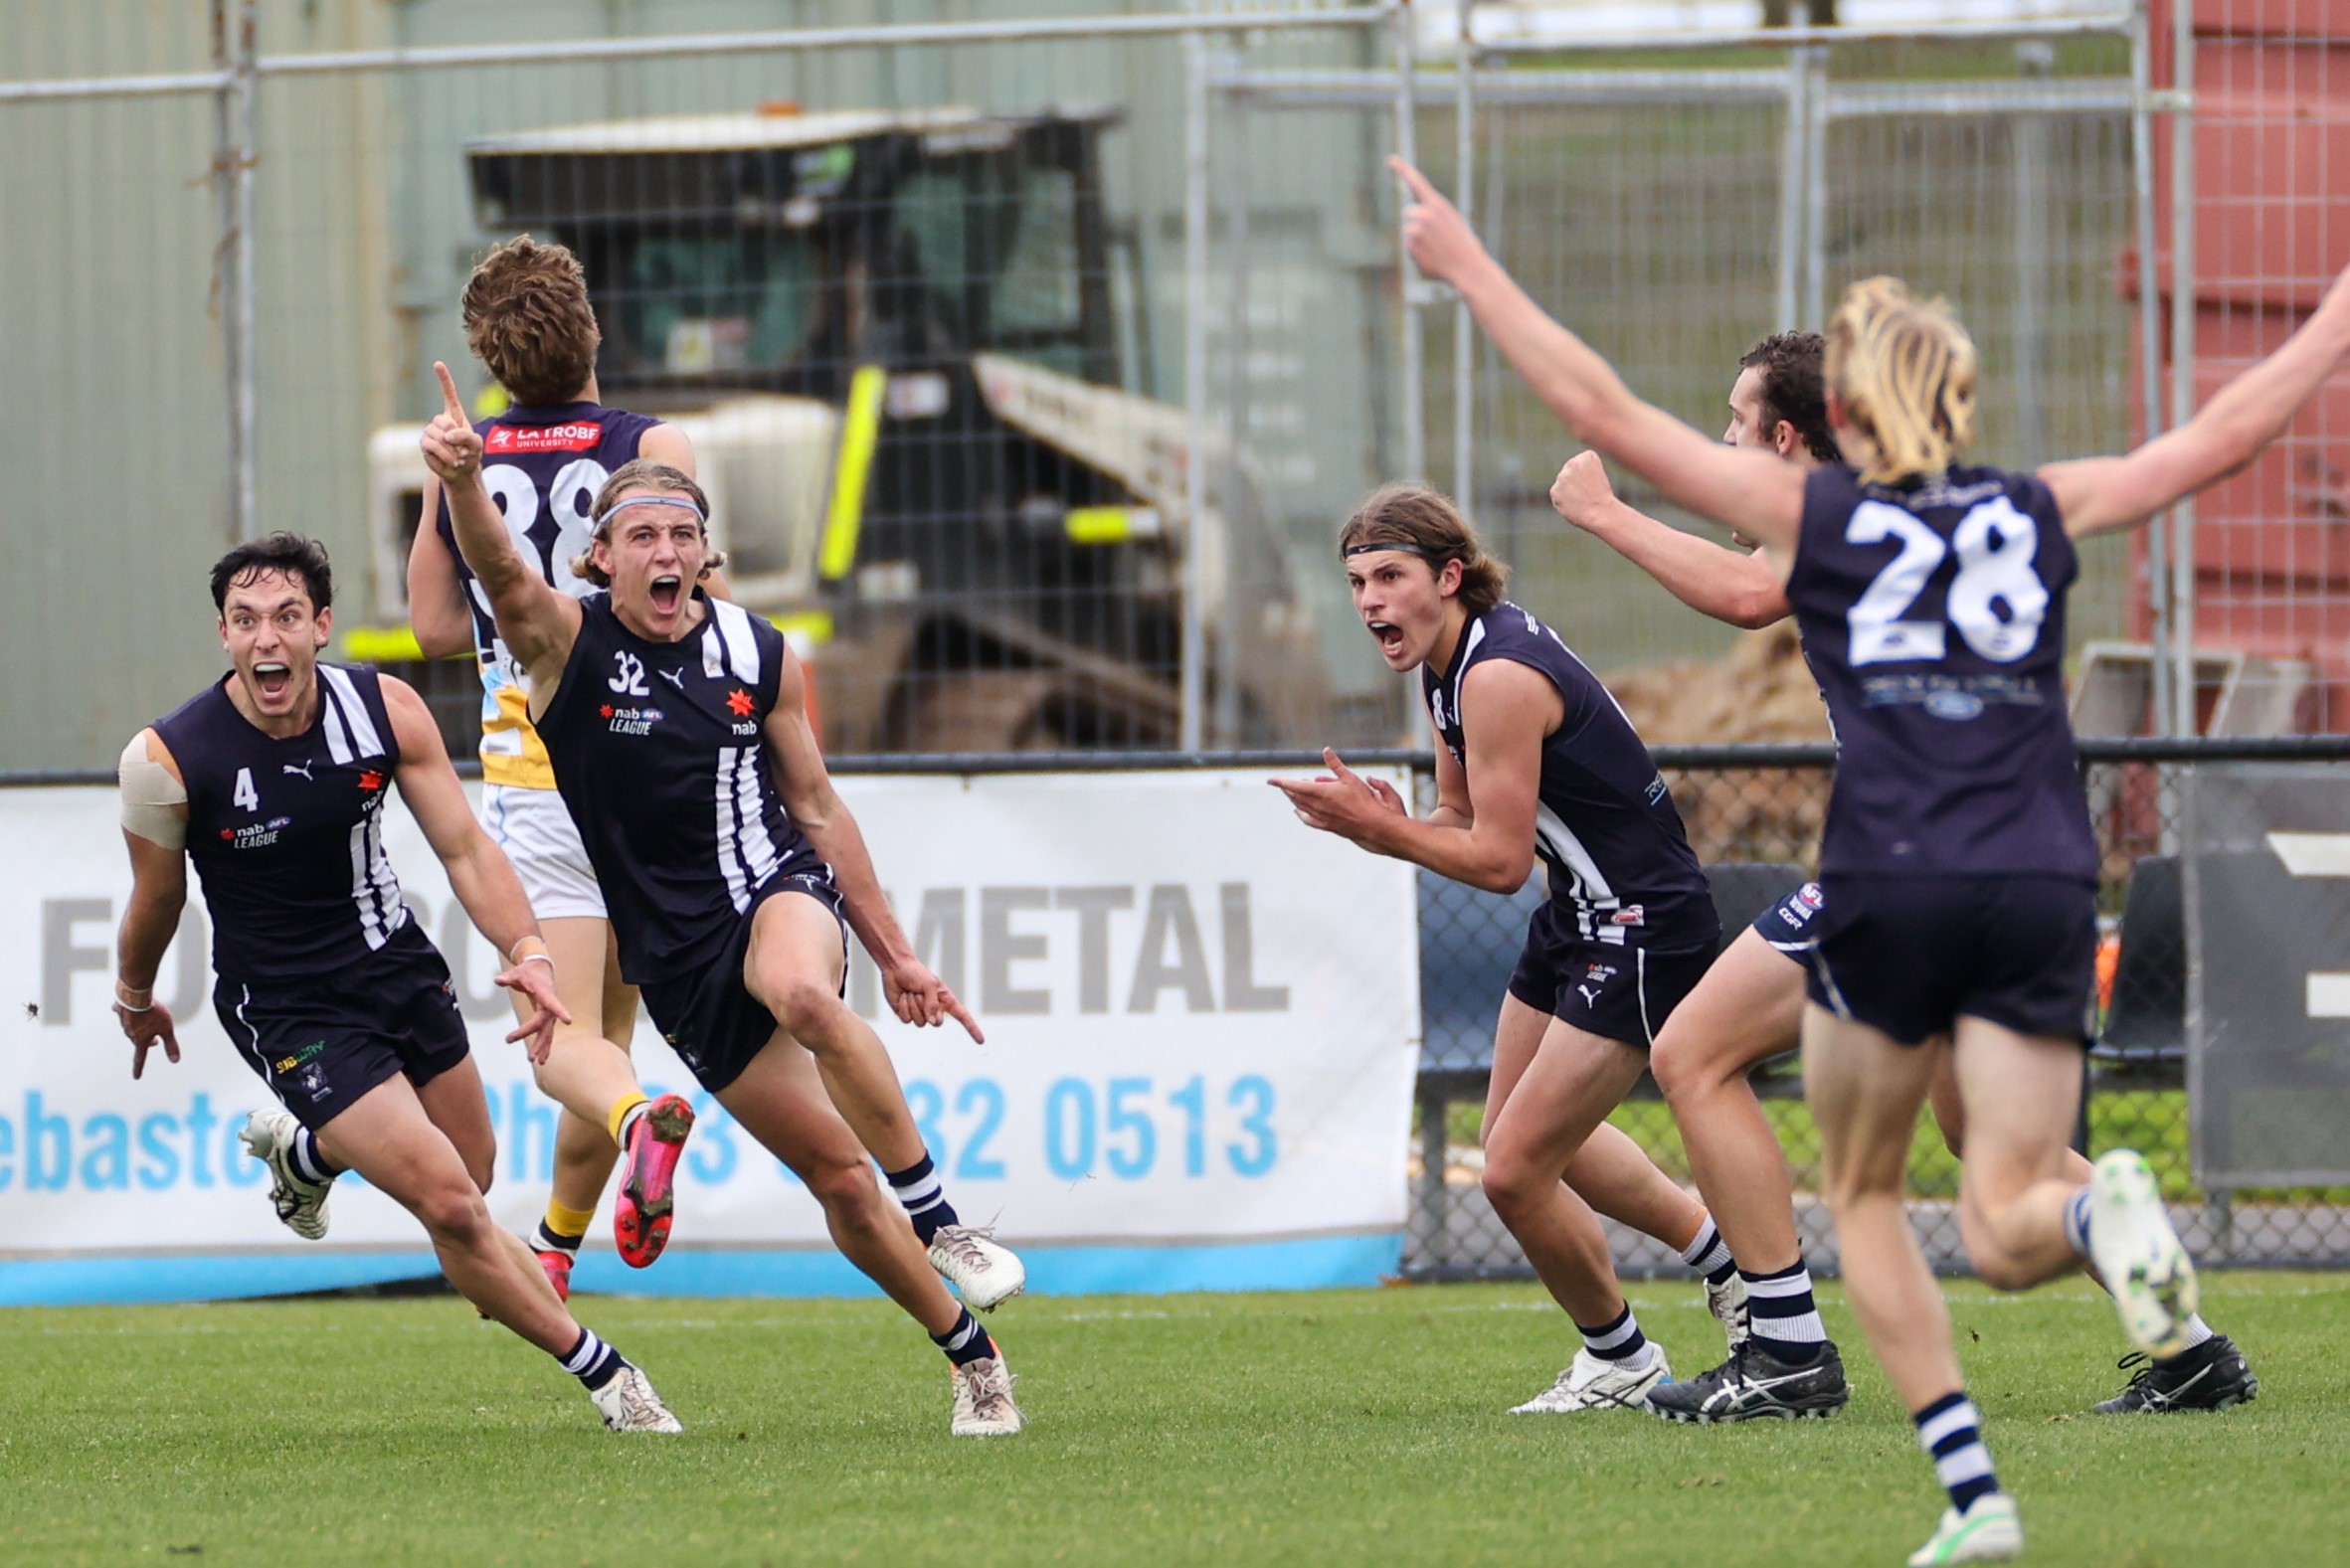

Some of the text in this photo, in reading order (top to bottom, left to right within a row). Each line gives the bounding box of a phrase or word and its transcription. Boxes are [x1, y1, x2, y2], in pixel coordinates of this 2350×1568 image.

[516, 438, 574, 448] UNIVERSITY
[1845, 495, 2050, 668] 28
[608, 649, 649, 696] 32
[609, 718, 651, 735] LEAGUE
[615, 708, 640, 720] nab
[732, 720, 757, 736] nab
[233, 767, 259, 812] 4
[234, 830, 279, 849] LEAGUE
[237, 822, 266, 838] nab
[847, 881, 1290, 1020] METAL
[275, 1039, 326, 1074] SUBWAY
[1044, 1073, 1279, 1180] 0513
